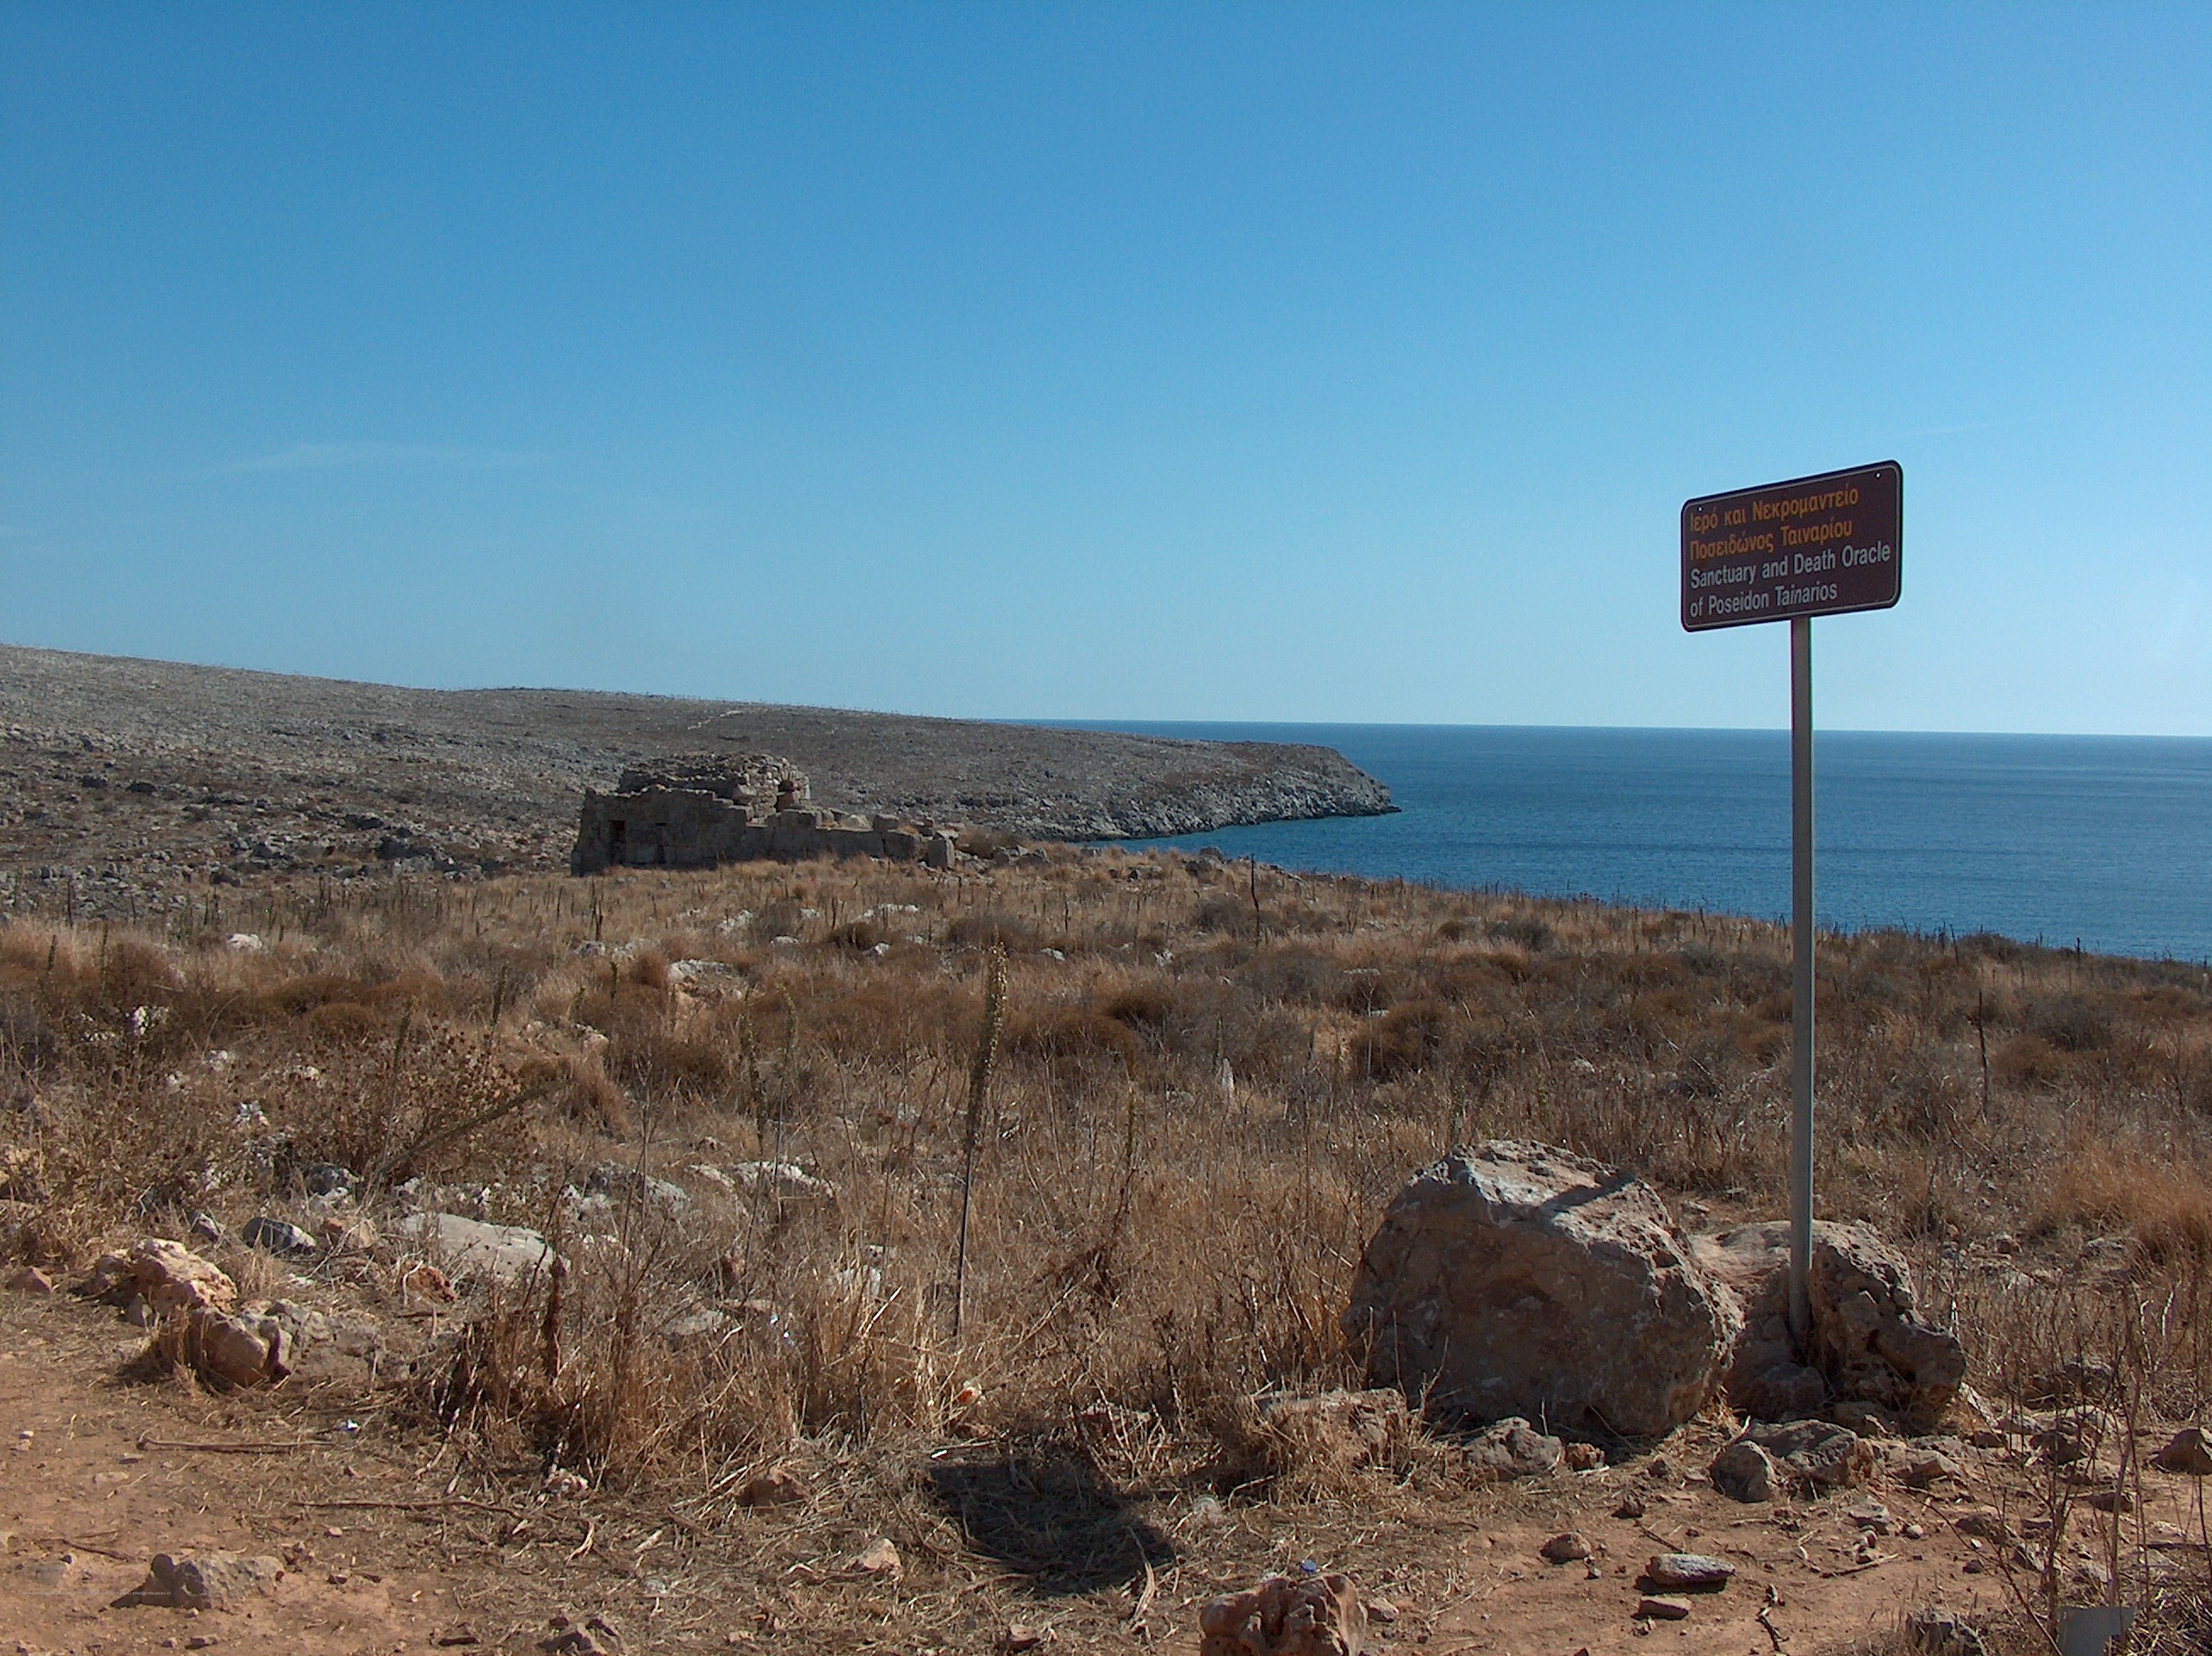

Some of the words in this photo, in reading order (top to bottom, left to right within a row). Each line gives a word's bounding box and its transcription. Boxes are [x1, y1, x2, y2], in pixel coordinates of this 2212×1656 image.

[1724, 508, 1746, 526] και
[1752, 483, 1858, 523] Νεκρομαντείο
[1690, 531, 1774, 561] Ποσειδώνος
[1781, 516, 1852, 547] Ταιναρίου
[1690, 564, 1757, 590] Sanctuary
[1762, 557, 1789, 579] and
[1794, 548, 1836, 574] Death
[1841, 540, 1891, 568] Oracle
[1690, 598, 1703, 618] of
[1708, 590, 1769, 616] Poseidon
[1774, 580, 1838, 607] Tainarios
